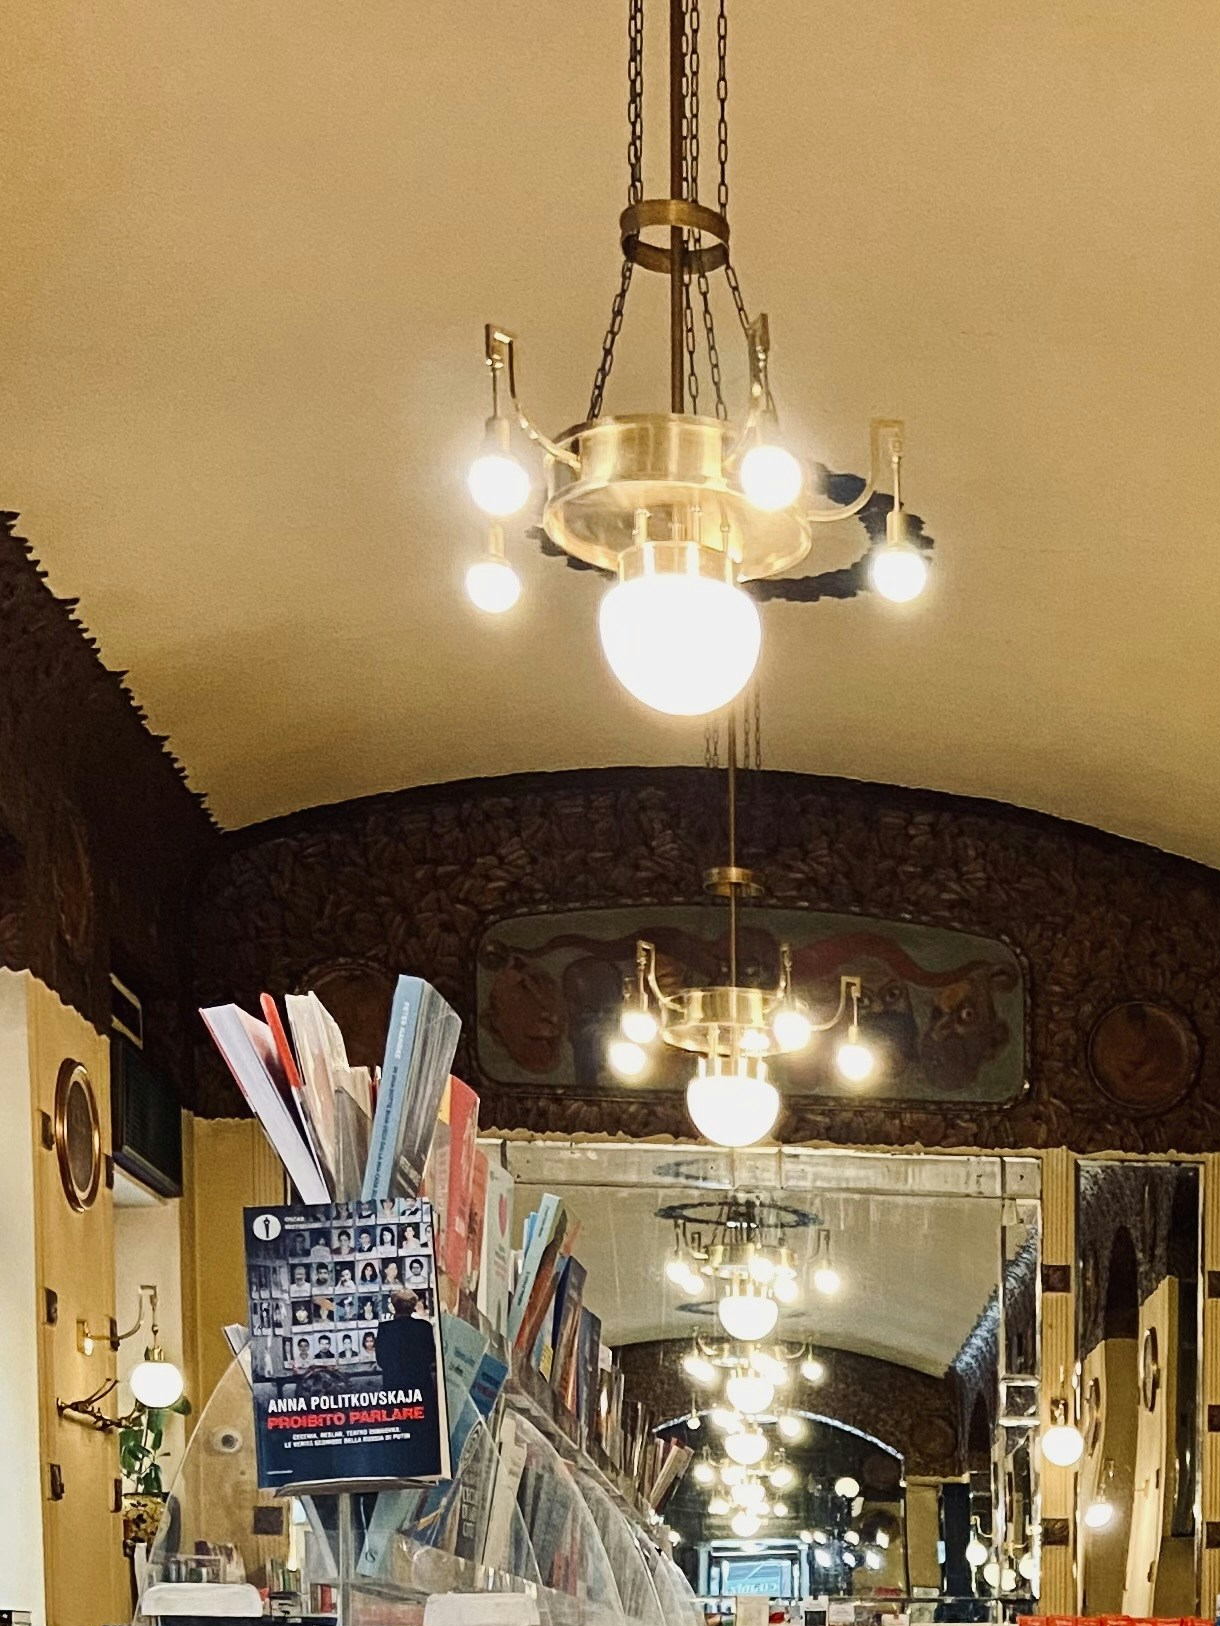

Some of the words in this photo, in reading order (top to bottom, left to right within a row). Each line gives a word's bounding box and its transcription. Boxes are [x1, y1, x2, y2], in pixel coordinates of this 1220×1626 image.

[267, 1397, 307, 1413] ANNA
[311, 1388, 422, 1411] POLITKOVSKAJA
[267, 1412, 346, 1429] PROIBITO
[350, 1406, 425, 1424] PARLARE
